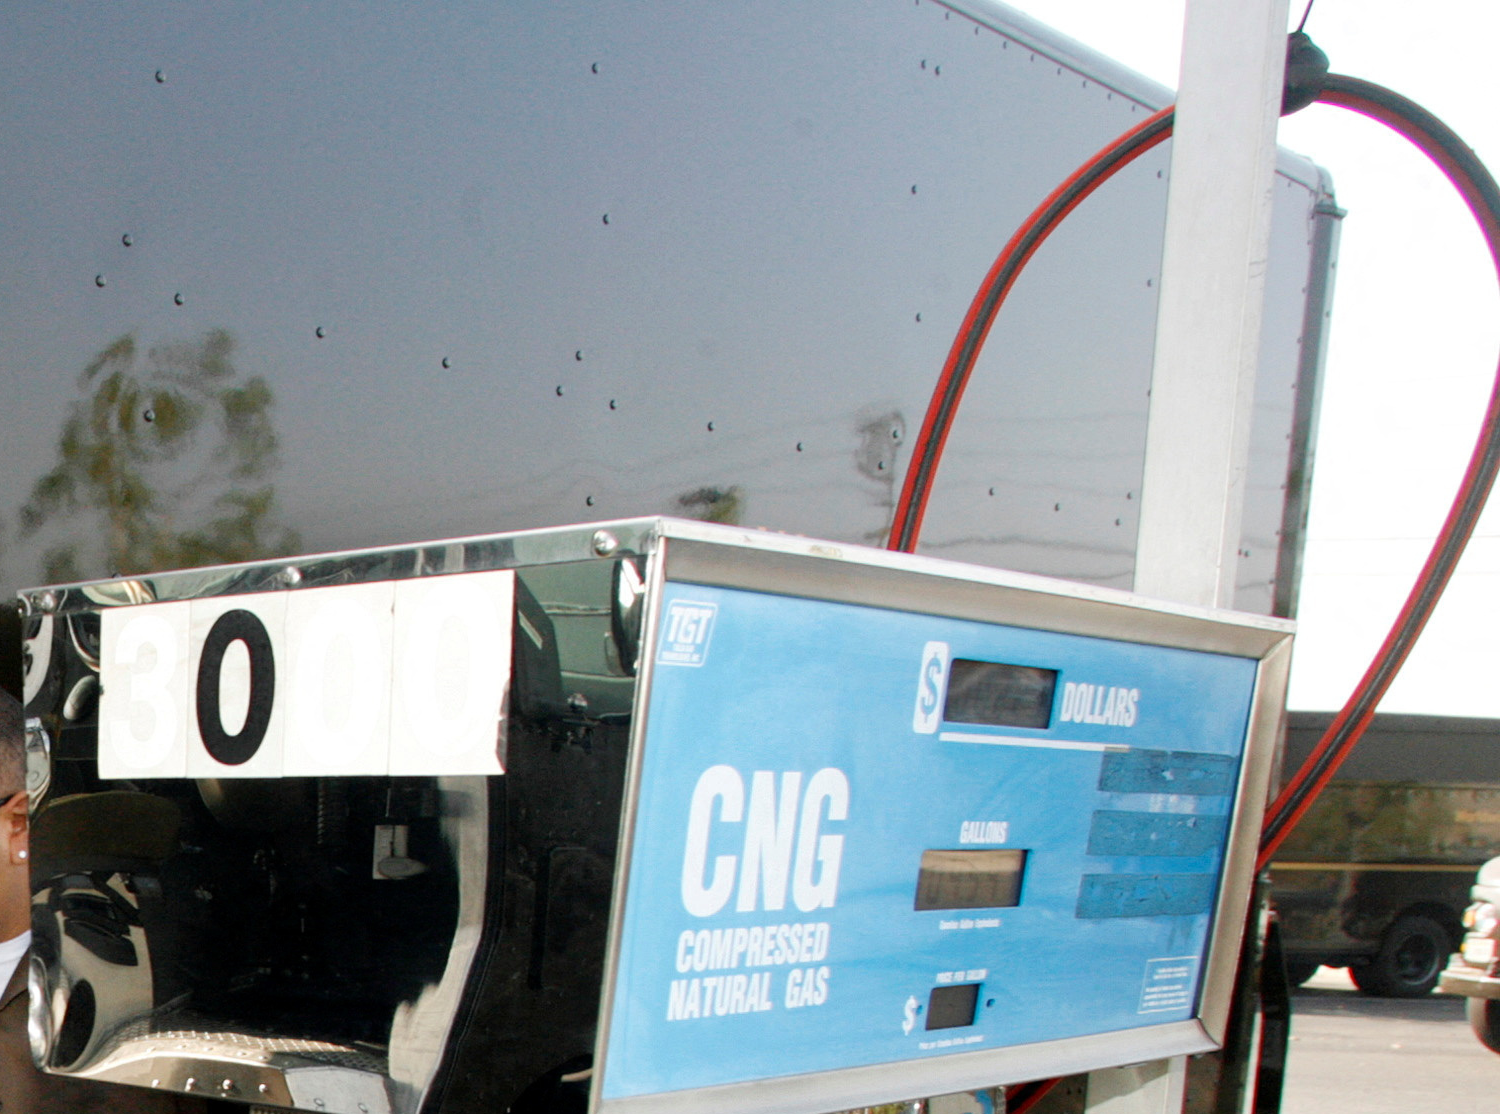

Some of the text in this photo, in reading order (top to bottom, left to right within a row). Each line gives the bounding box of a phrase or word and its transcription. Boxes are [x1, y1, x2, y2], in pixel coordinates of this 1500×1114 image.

[667, 606, 714, 644] TGT
[1060, 682, 1139, 727] DOLLARS
[681, 764, 849, 917] CNG
[959, 820, 1009, 844] GALLONS
[676, 922, 830, 973] COMPRESSED
[666, 966, 830, 1021] NATURAL GAS
